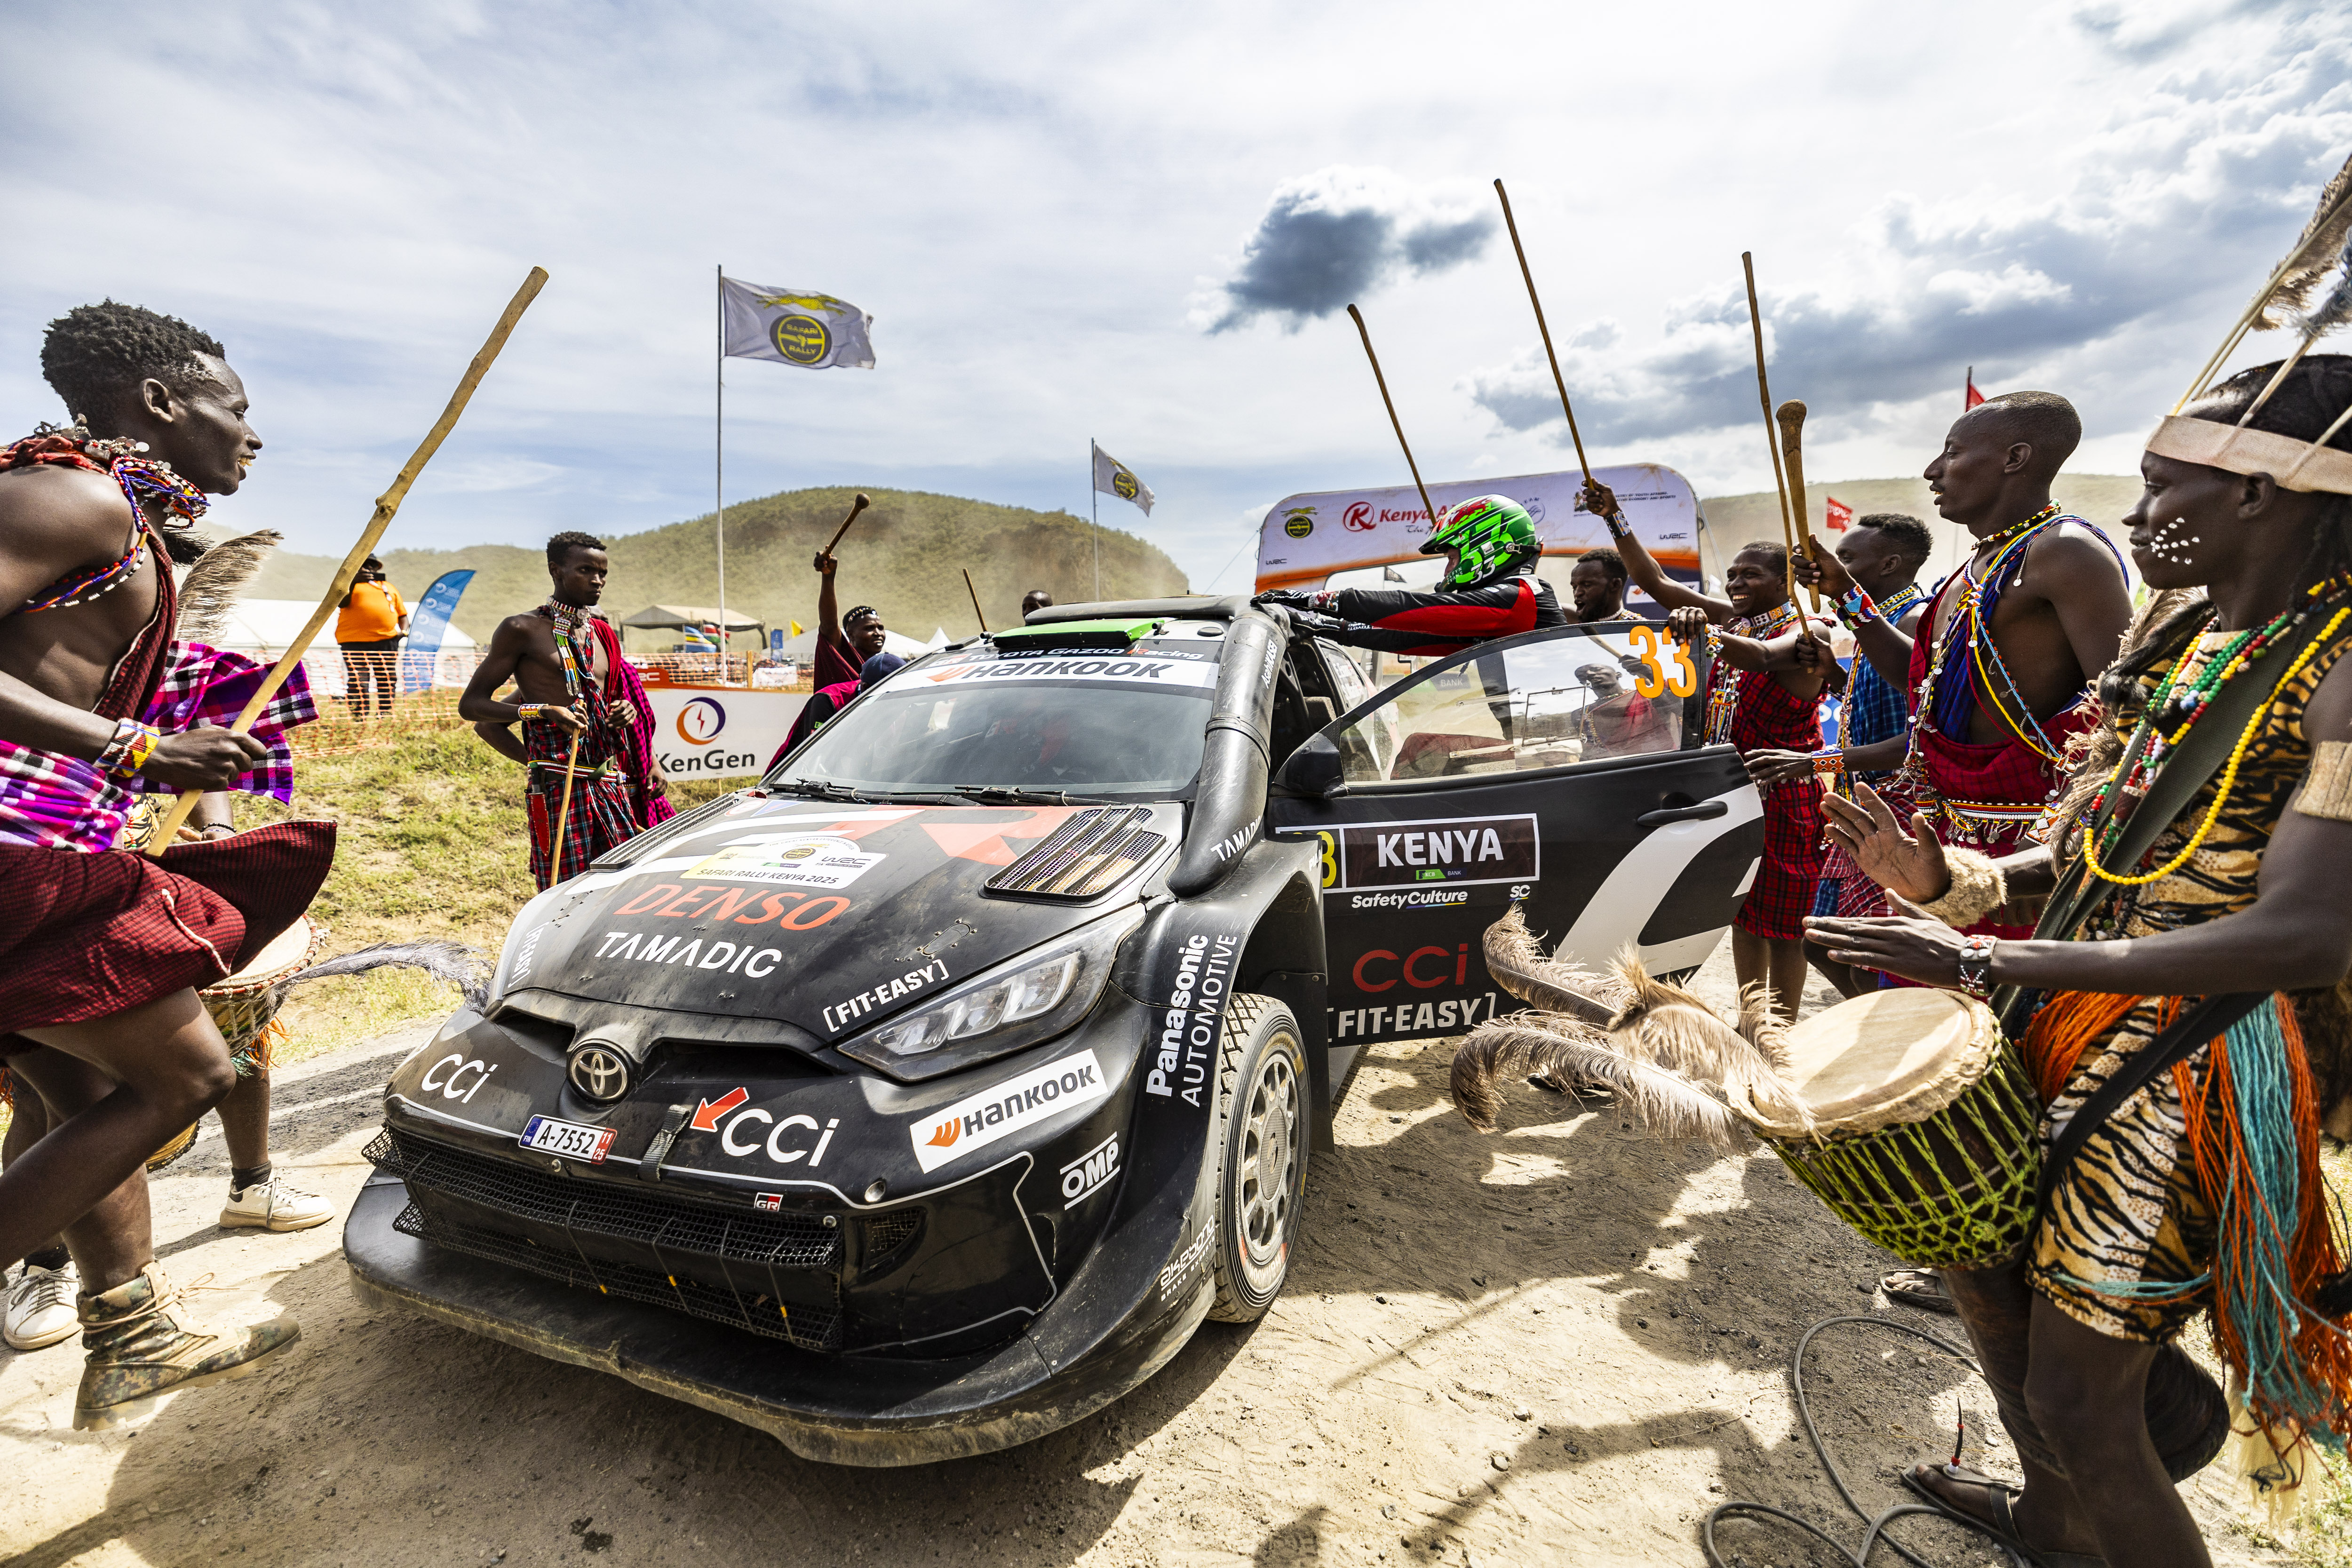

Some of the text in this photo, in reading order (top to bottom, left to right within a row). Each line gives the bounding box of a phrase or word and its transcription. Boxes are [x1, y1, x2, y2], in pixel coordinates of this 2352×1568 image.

[786, 323, 818, 335] SAFARI
[788, 344, 817, 355] RALLY
[1380, 509, 1431, 523] Kenya
[1470, 555, 1495, 584] 33
[969, 650, 1044, 661] TOYOTA
[1127, 648, 1205, 660] Racing
[1629, 626, 1697, 698] 33
[656, 749, 755, 773] KenGen
[1377, 828, 1504, 867] KENYA
[821, 856, 872, 865] WRC
[768, 872, 806, 881] KENYA
[805, 876, 840, 884] 2025
[1351, 890, 1468, 909] SafetyCulture
[1510, 884, 1531, 898] SC
[612, 884, 851, 931] DENSO
[594, 931, 783, 979] TAMADIC
[1146, 934, 1208, 1097] Panasonic
[1181, 934, 1238, 1107] AUTOMOTIVE
[523, 1124, 596, 1154] FIN A-7552
[601, 1132, 612, 1144] 11
[593, 1147, 605, 1161] 25
[1062, 1141, 1119, 1198] OMP
[756, 1200, 779, 1211] GR
[1161, 1235, 1215, 1302] BRAKE EXPERTS
